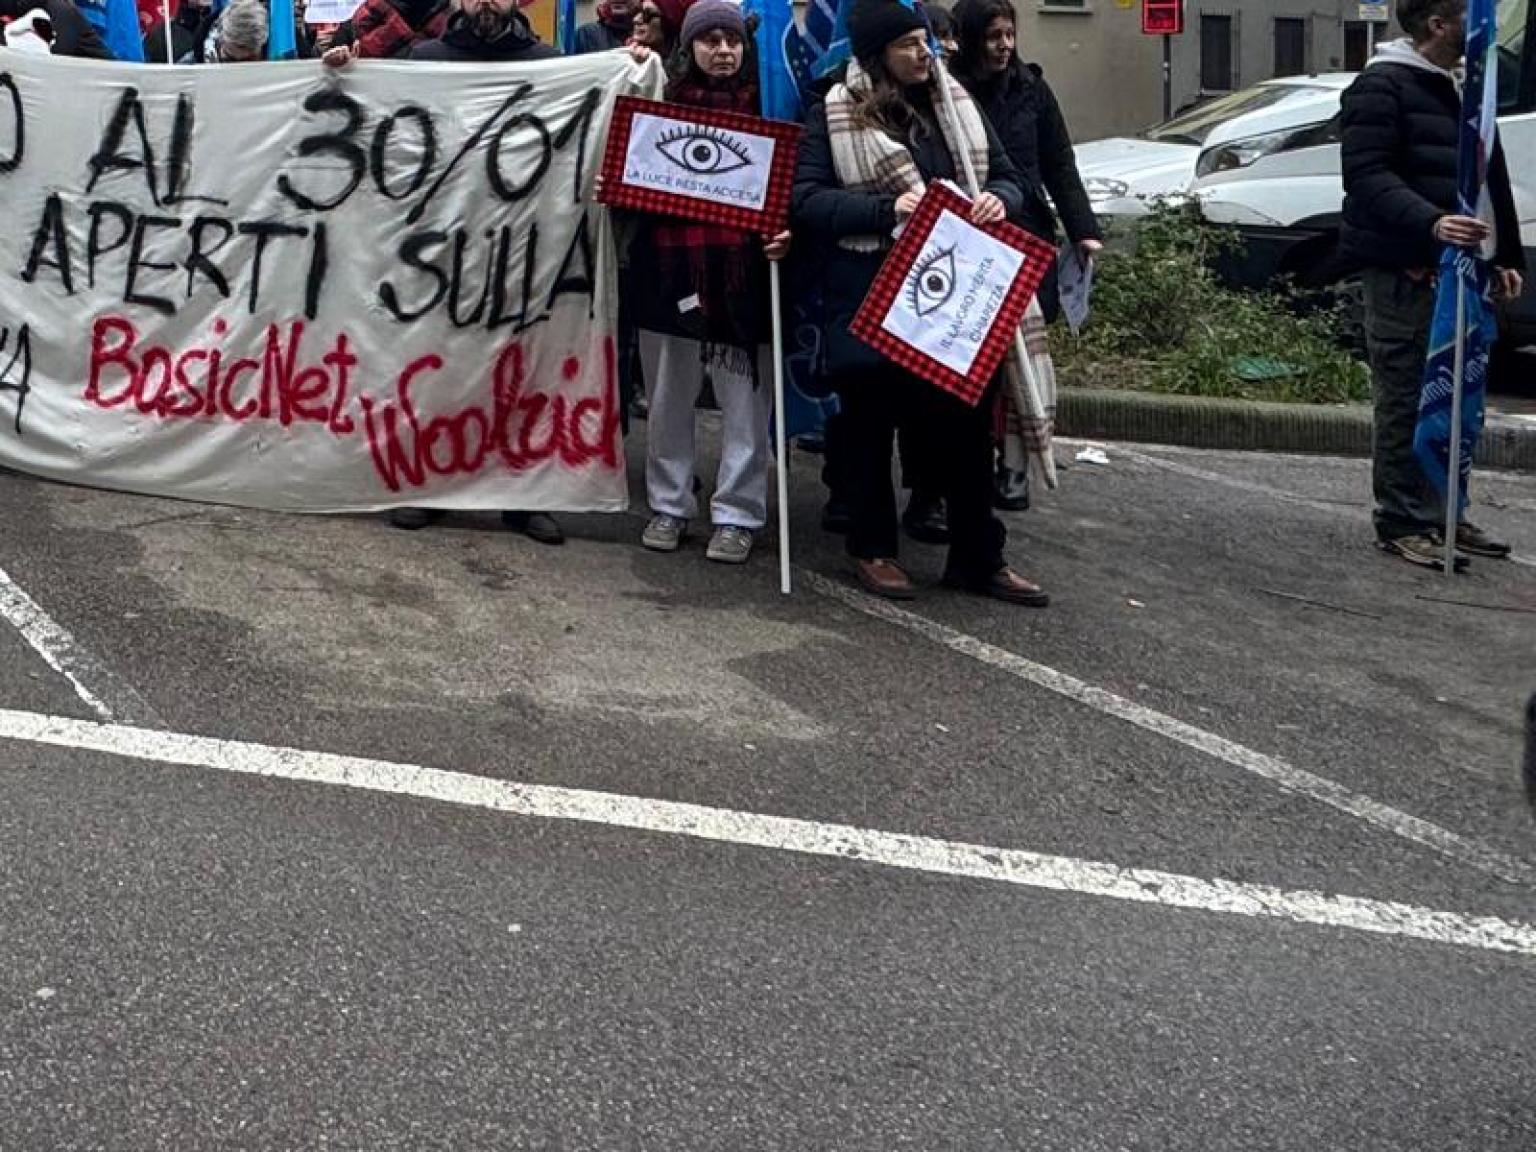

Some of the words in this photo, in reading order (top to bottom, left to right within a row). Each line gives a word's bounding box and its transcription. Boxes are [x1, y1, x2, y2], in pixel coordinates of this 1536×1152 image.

[87, 87, 229, 208] AL
[277, 82, 602, 225] 30/01
[627, 168, 641, 181] LA
[642, 171, 673, 187] LUCE
[674, 176, 710, 195] RESTA
[711, 183, 762, 204] ACCESA
[19, 191, 327, 321] APERTI
[378, 210, 598, 335] SULLA
[84, 313, 358, 434] BasicNet
